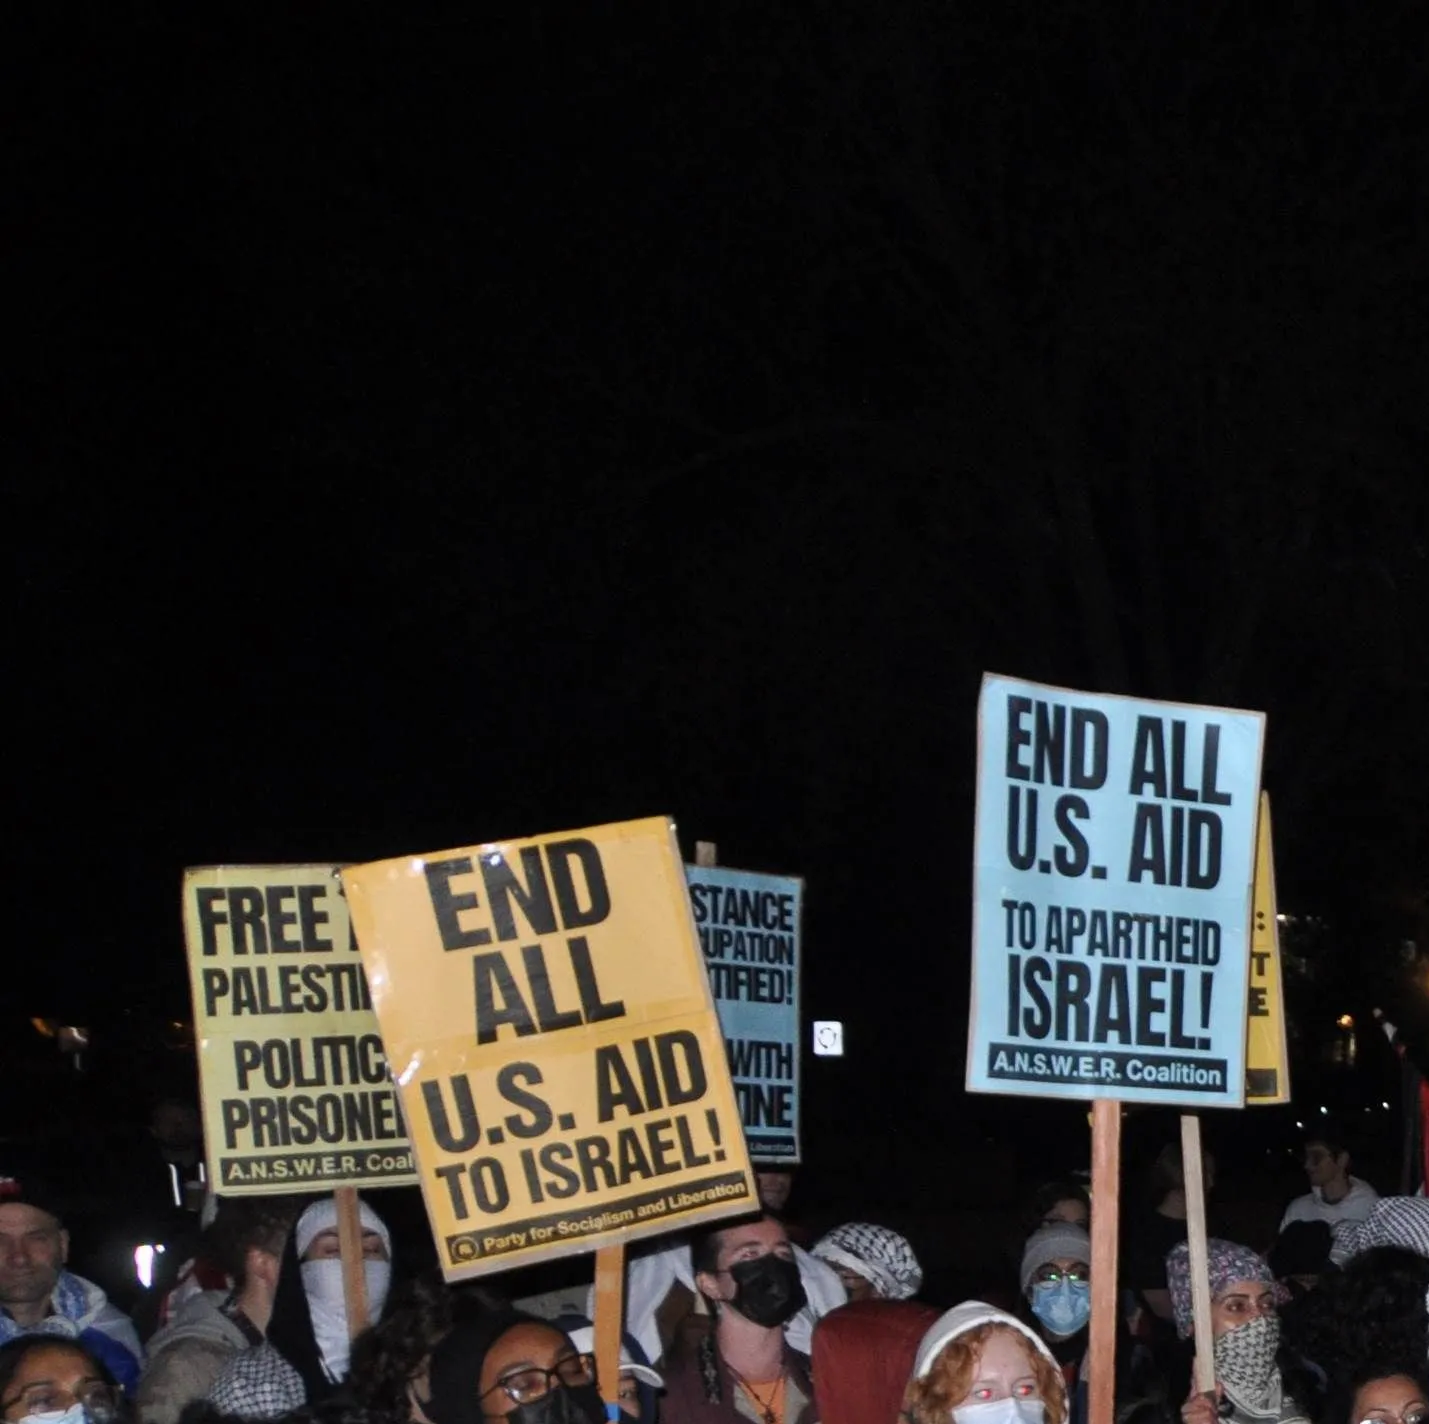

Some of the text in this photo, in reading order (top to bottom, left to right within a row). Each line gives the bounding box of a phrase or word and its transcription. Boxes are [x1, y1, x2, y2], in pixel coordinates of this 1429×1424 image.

[1006, 694, 1232, 806] END ALL
[1007, 785, 1223, 890] U.S. AID
[196, 884, 333, 956] FREE
[424, 837, 611, 952] END
[1002, 899, 1037, 950] TO
[1045, 905, 1221, 966] APARTHEID
[472, 934, 626, 1045] ALL
[1007, 954, 1213, 1050] ISRAEL!
[233, 1034, 391, 1091] POLITIC
[420, 1029, 708, 1155] U.S. AID
[993, 1051, 1221, 1086] A.N.S.W.E.R. Coalition
[228, 1155, 361, 1180] A.N.S.W.E.R.
[435, 1108, 727, 1221] TO ISRAEL!
[484, 1232, 527, 1251] Party
[530, 1225, 556, 1242] for
[556, 1208, 634, 1234] Socialism
[637, 1198, 665, 1216] and
[668, 1179, 746, 1208] Liberation
